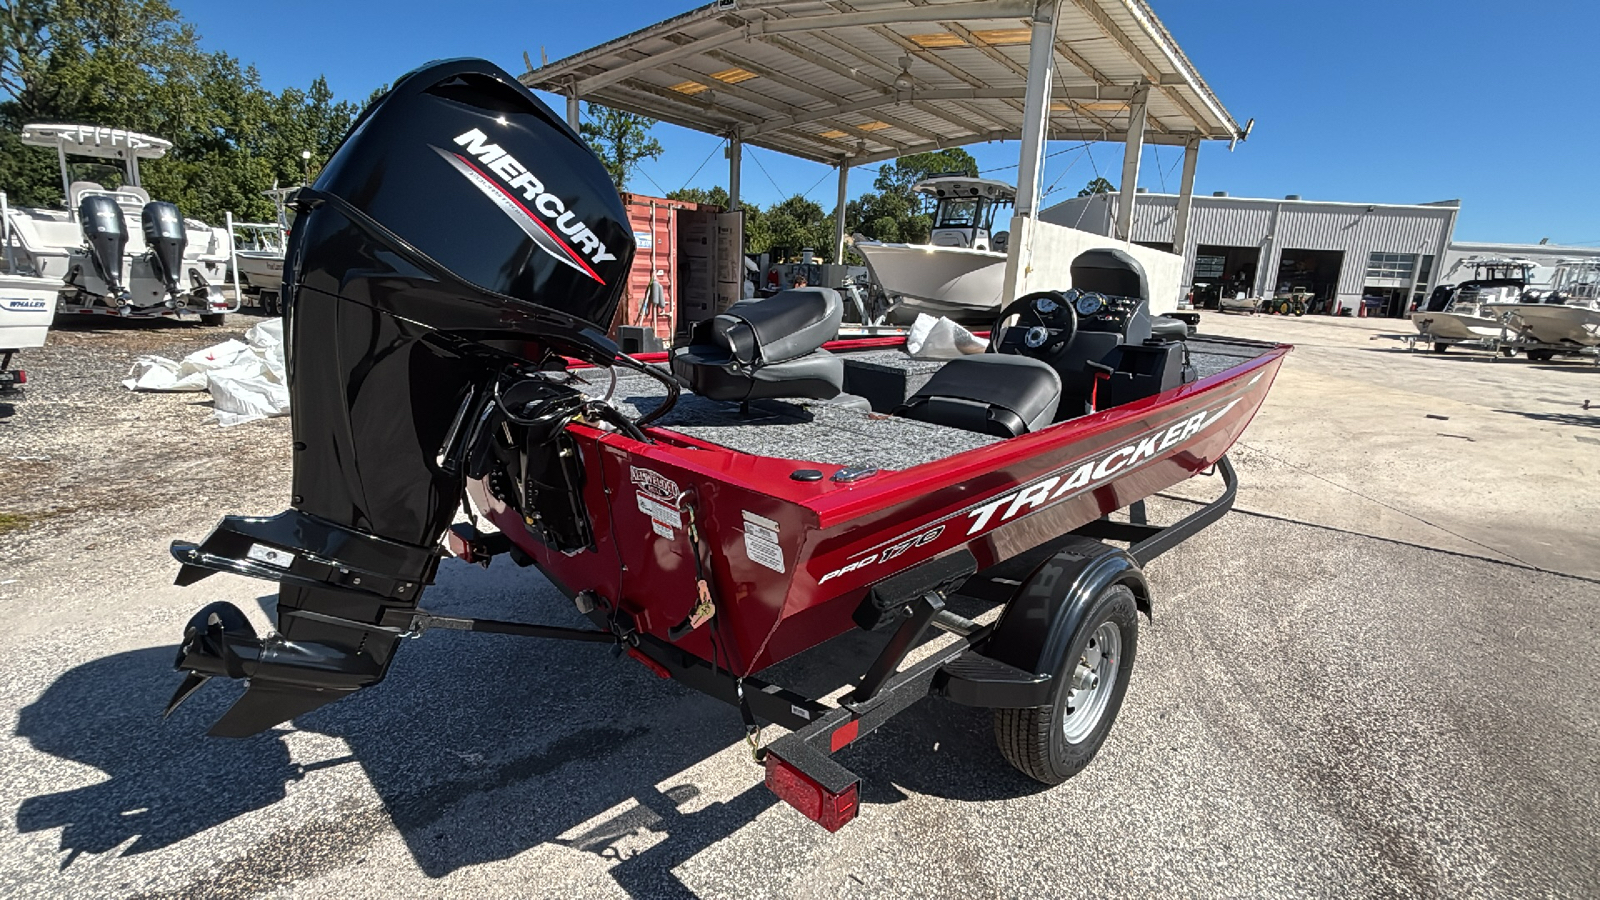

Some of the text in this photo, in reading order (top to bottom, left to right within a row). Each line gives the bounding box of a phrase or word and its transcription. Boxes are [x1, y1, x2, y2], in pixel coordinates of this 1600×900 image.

[453, 127, 617, 264] MERCURY
[966, 409, 1211, 535] TRACKER
[818, 554, 878, 585] PRO
